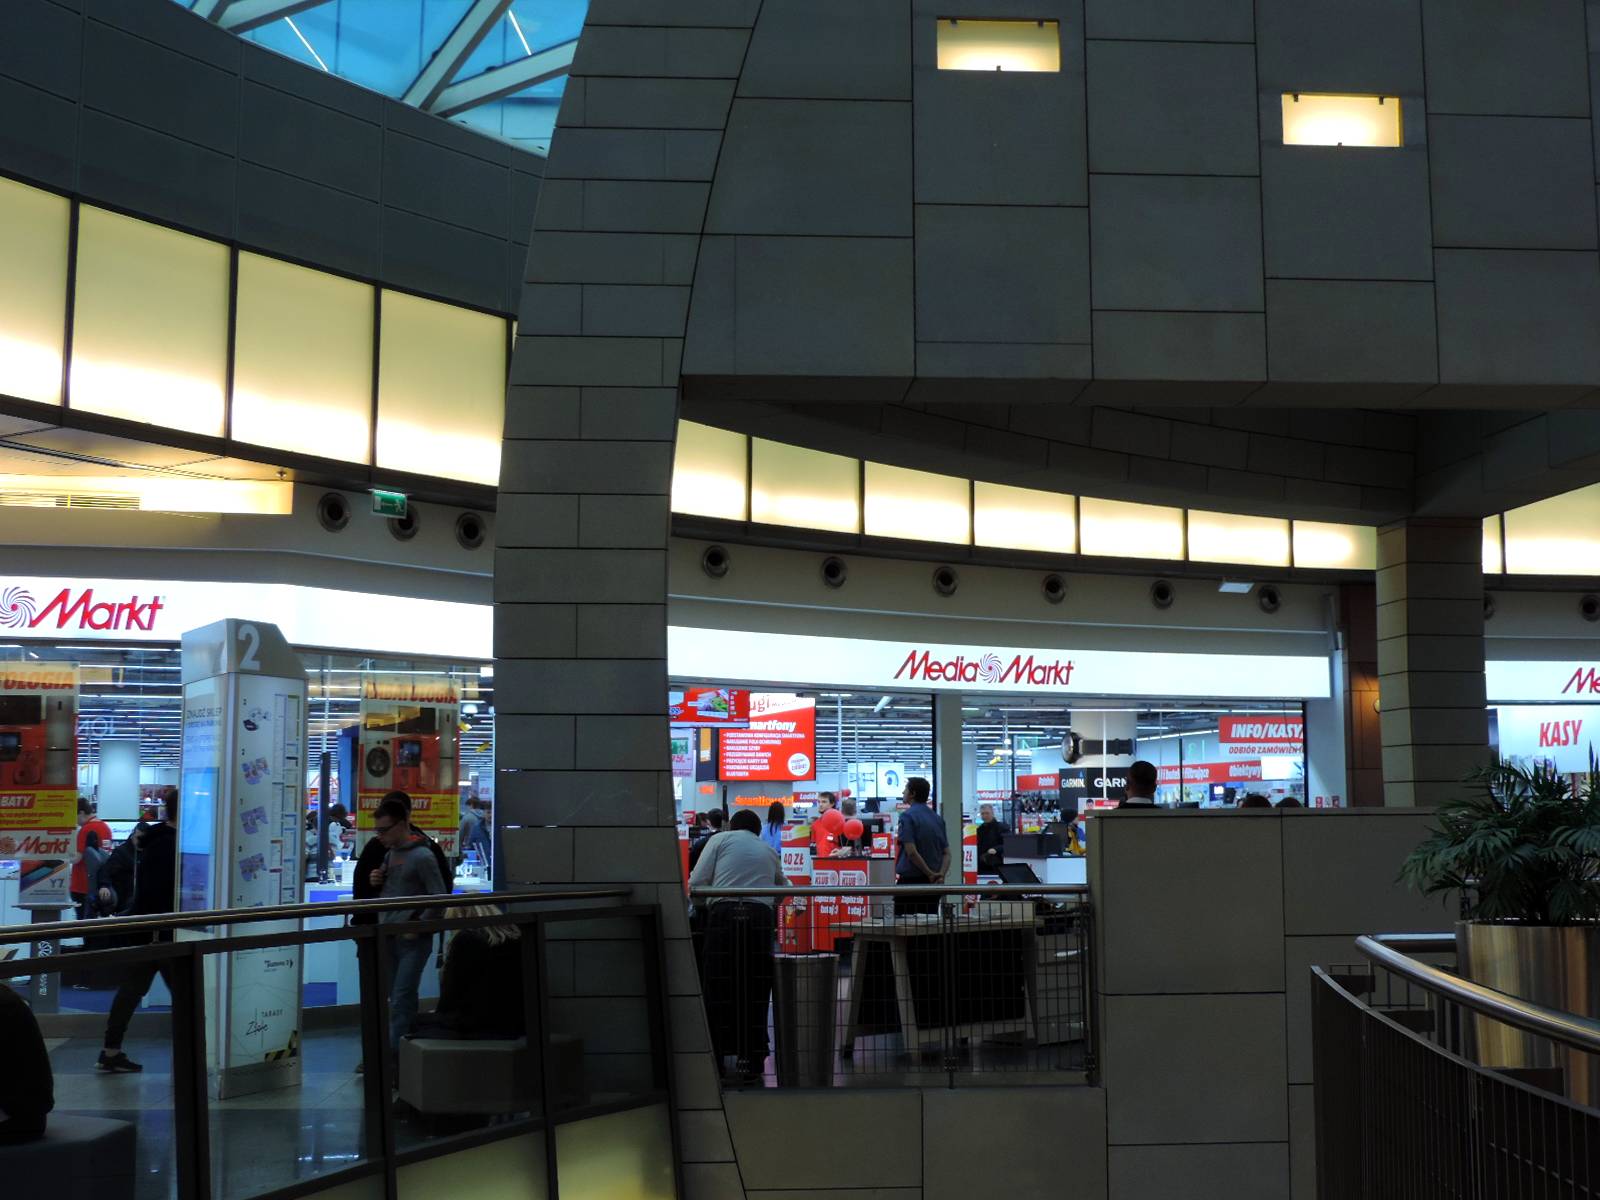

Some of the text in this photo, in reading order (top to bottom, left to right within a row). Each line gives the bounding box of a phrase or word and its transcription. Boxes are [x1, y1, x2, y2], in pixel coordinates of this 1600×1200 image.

[28, 588, 164, 631] Markt
[239, 624, 261, 671] 2
[894, 650, 1074, 685] Media Markt
[1539, 719, 1583, 747] KASY
[1061, 778, 1085, 789] GARMIN
[15, 836, 71, 855] Markt
